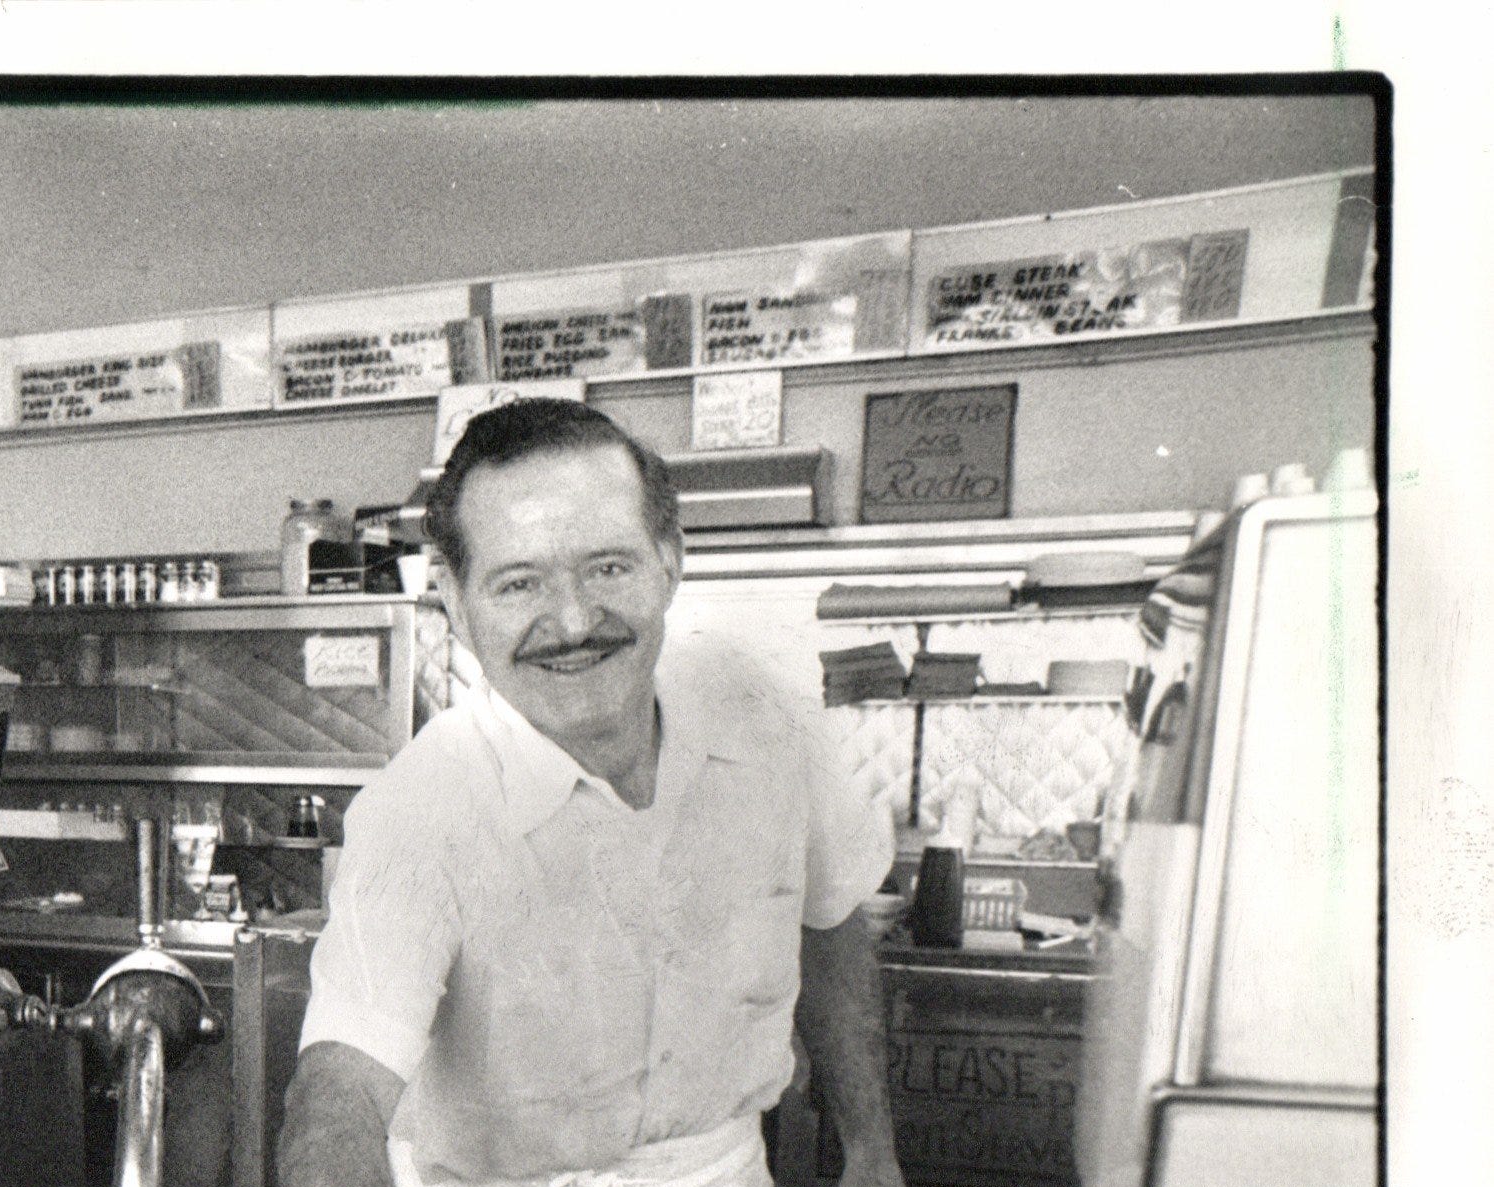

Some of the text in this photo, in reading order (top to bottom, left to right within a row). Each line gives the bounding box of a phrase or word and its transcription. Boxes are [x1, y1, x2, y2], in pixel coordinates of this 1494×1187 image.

[940, 261, 1084, 292] CUBE STEAK
[1062, 293, 1135, 320] STAK
[282, 335, 380, 355] HAMBURGER
[500, 334, 544, 351] FRIED
[552, 331, 584, 348] EGG
[501, 345, 611, 369] RICE PUDDING
[284, 373, 334, 390] BACON
[361, 362, 422, 381] TOMATO
[284, 380, 396, 401] CHEESE OMELET
[882, 394, 1005, 428] Please
[878, 458, 1001, 500] Radio
[886, 1039, 1040, 1100] PLEASE
